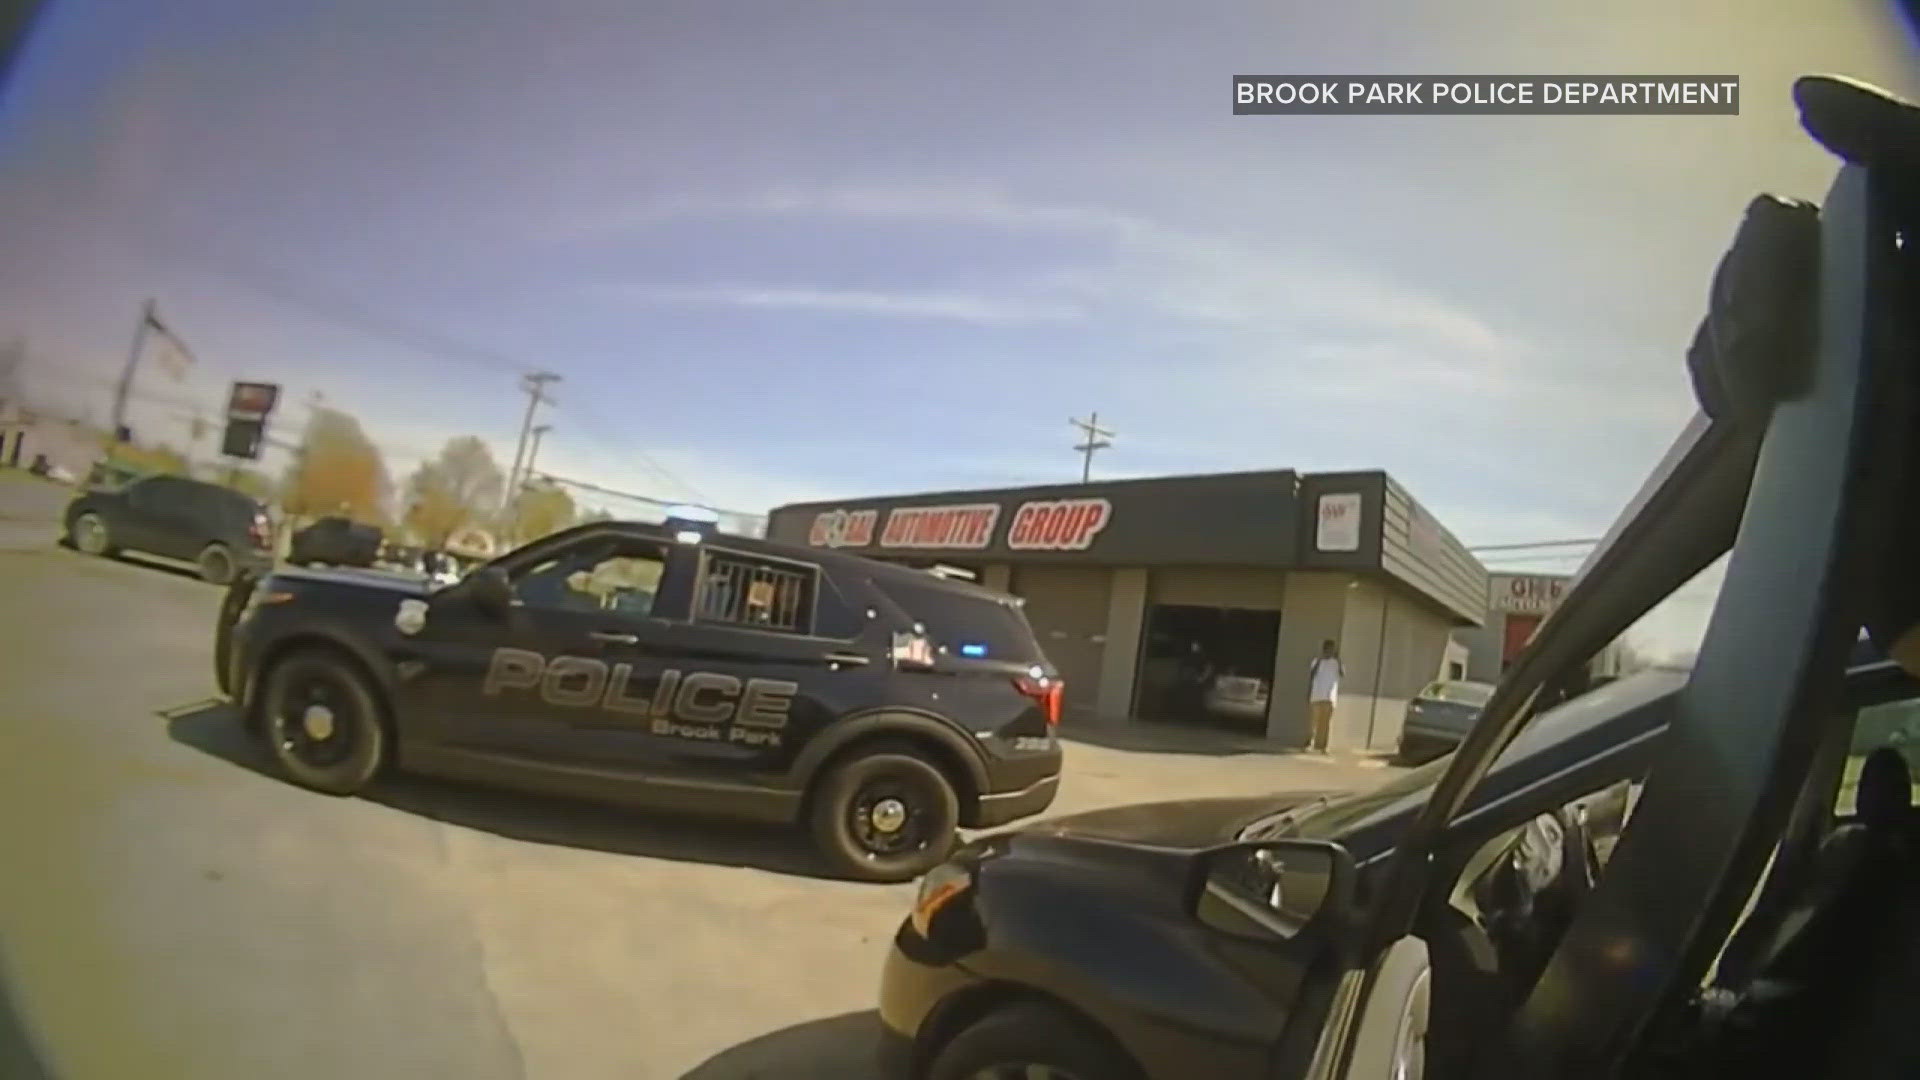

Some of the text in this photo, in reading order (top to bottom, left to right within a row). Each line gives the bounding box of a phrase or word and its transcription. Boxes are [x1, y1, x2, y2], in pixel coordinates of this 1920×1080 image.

[1008, 499, 1112, 549] GROUP
[483, 646, 798, 729] POLICE
[652, 719, 782, 746] Brook Park
